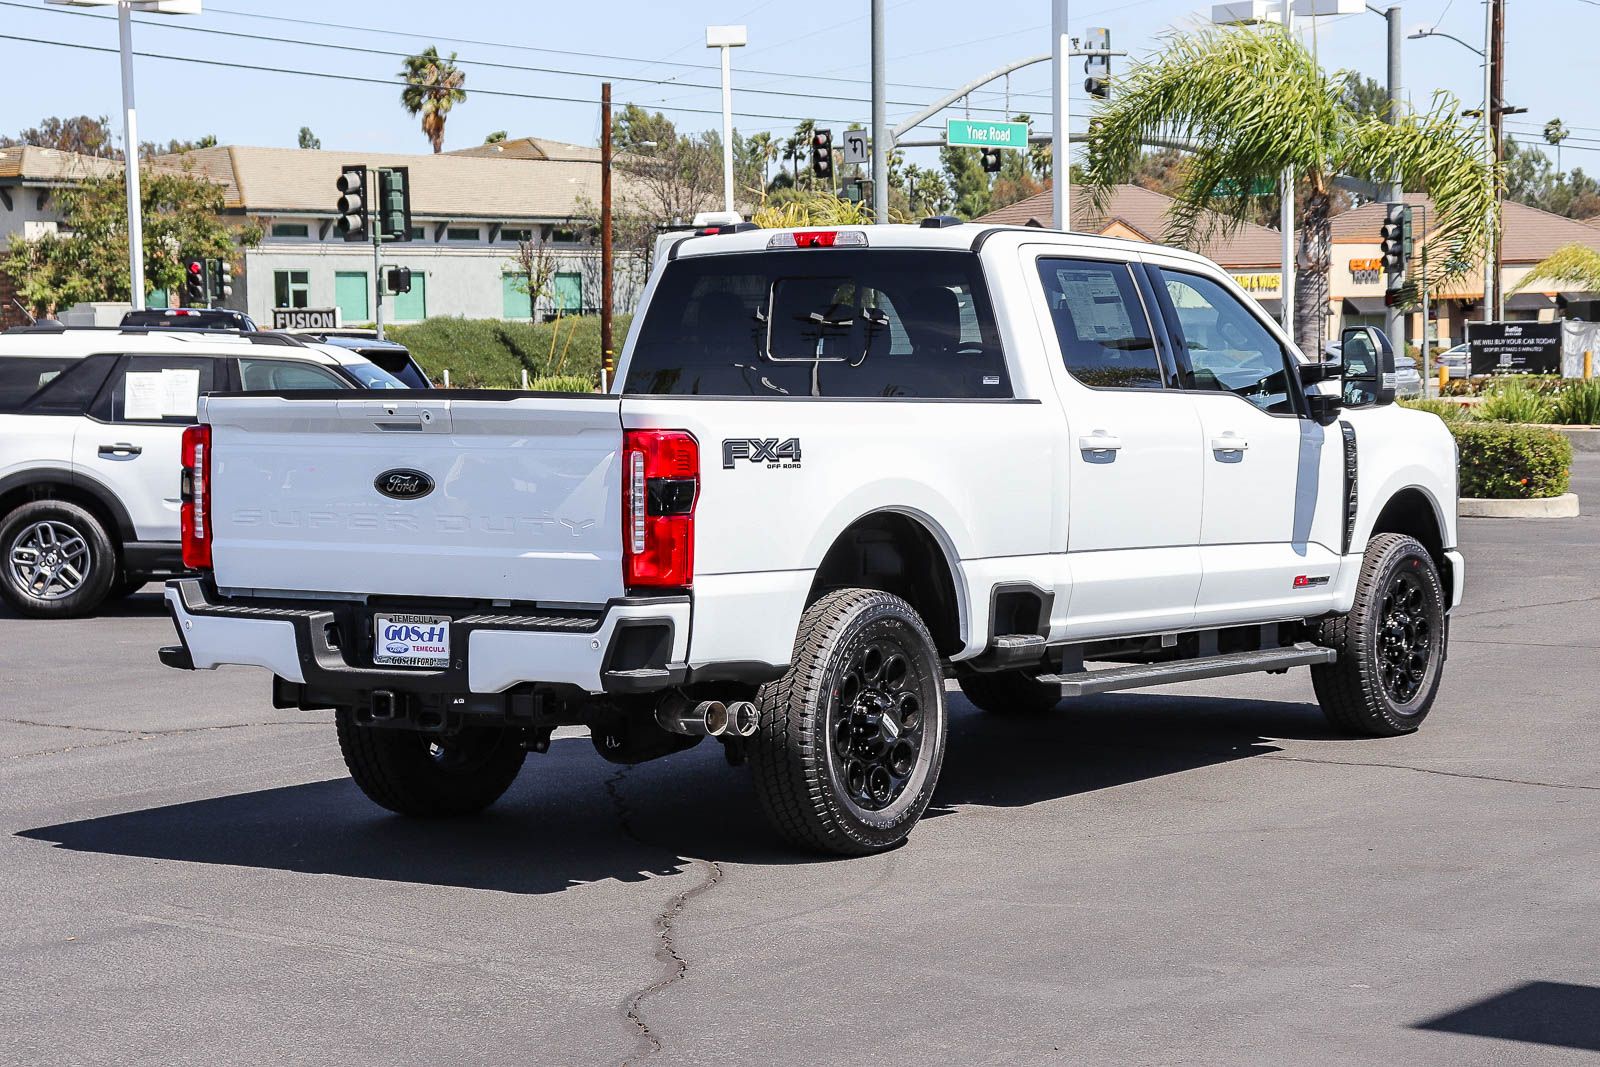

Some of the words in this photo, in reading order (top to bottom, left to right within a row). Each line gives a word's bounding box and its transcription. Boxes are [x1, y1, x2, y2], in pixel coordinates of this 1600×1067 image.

[966, 124, 988, 140] Ynez
[989, 126, 1011, 142] Road
[1259, 273, 1281, 289] WIGS
[275, 312, 335, 329] FUSION
[1523, 337, 1535, 345] CAR
[1536, 337, 1557, 345] TODAY
[721, 437, 802, 470] FX4
[386, 474, 420, 493] Ford
[231, 508, 418, 532] SUPER
[434, 513, 597, 538] DUTY
[392, 614, 434, 624] TEMECULA
[412, 645, 446, 653] TEMECULA
